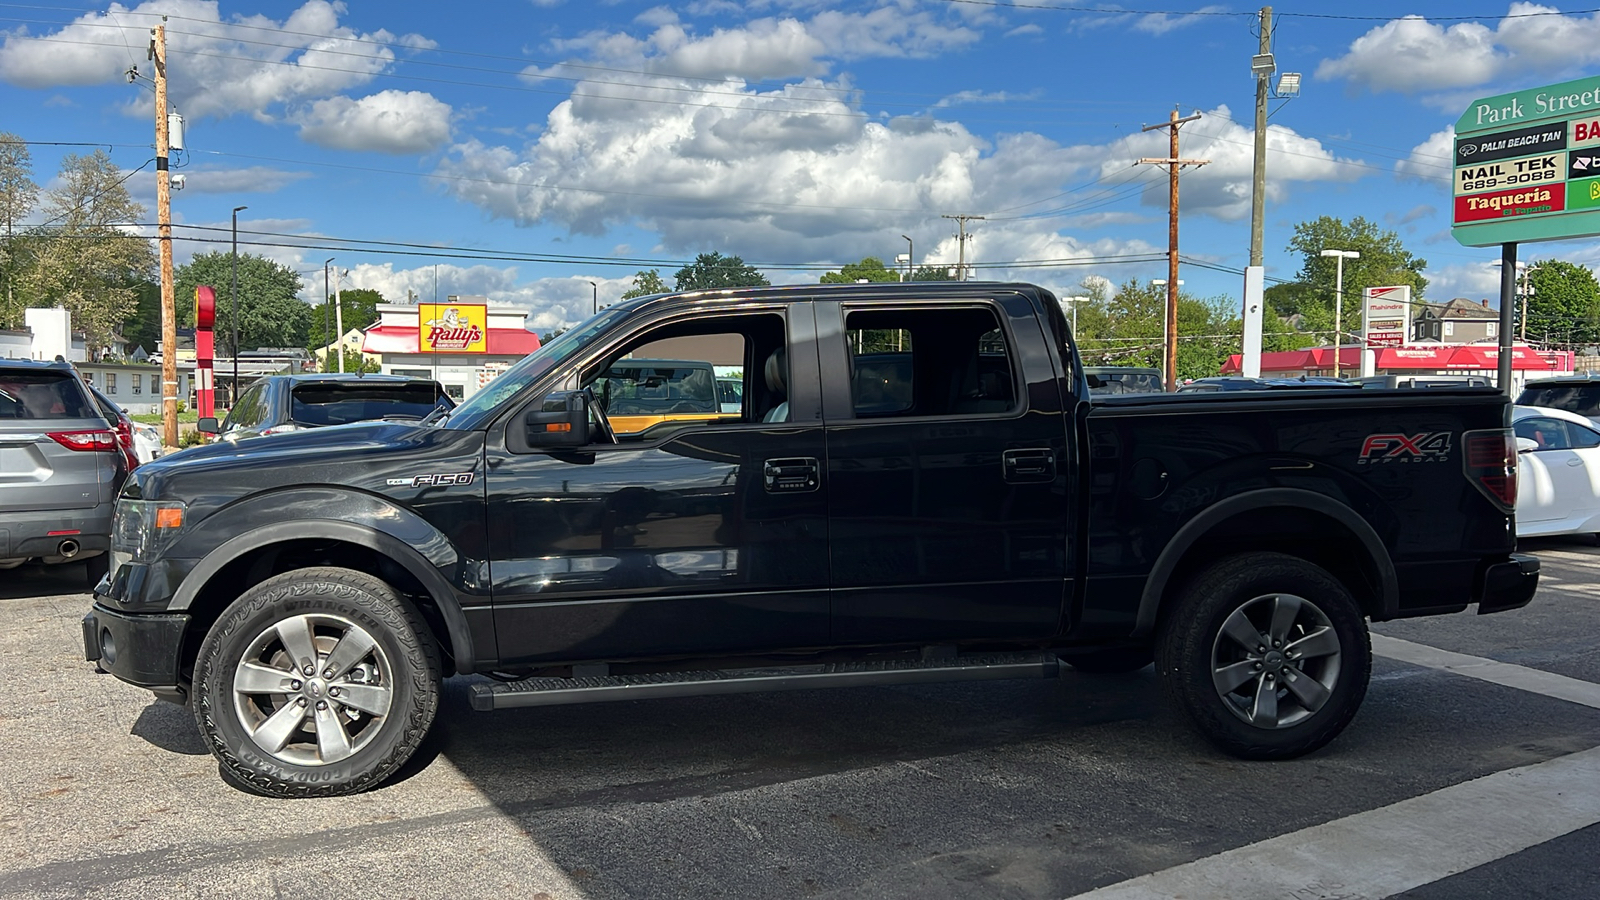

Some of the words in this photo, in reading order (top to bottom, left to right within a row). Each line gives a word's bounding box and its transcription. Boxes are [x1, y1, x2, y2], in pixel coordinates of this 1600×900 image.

[1476, 98, 1524, 125] Park
[1535, 86, 1600, 114] Street
[1480, 141, 1506, 153] PALM
[1507, 135, 1539, 148] BEACH
[1541, 130, 1562, 142] TAN
[1461, 165, 1506, 181] NAIL
[1514, 156, 1557, 172] TEK
[1463, 169, 1556, 191] 689-9088
[427, 325, 482, 348] Rally's
[1359, 431, 1453, 458] FX4
[285, 600, 379, 629] WRANGLER
